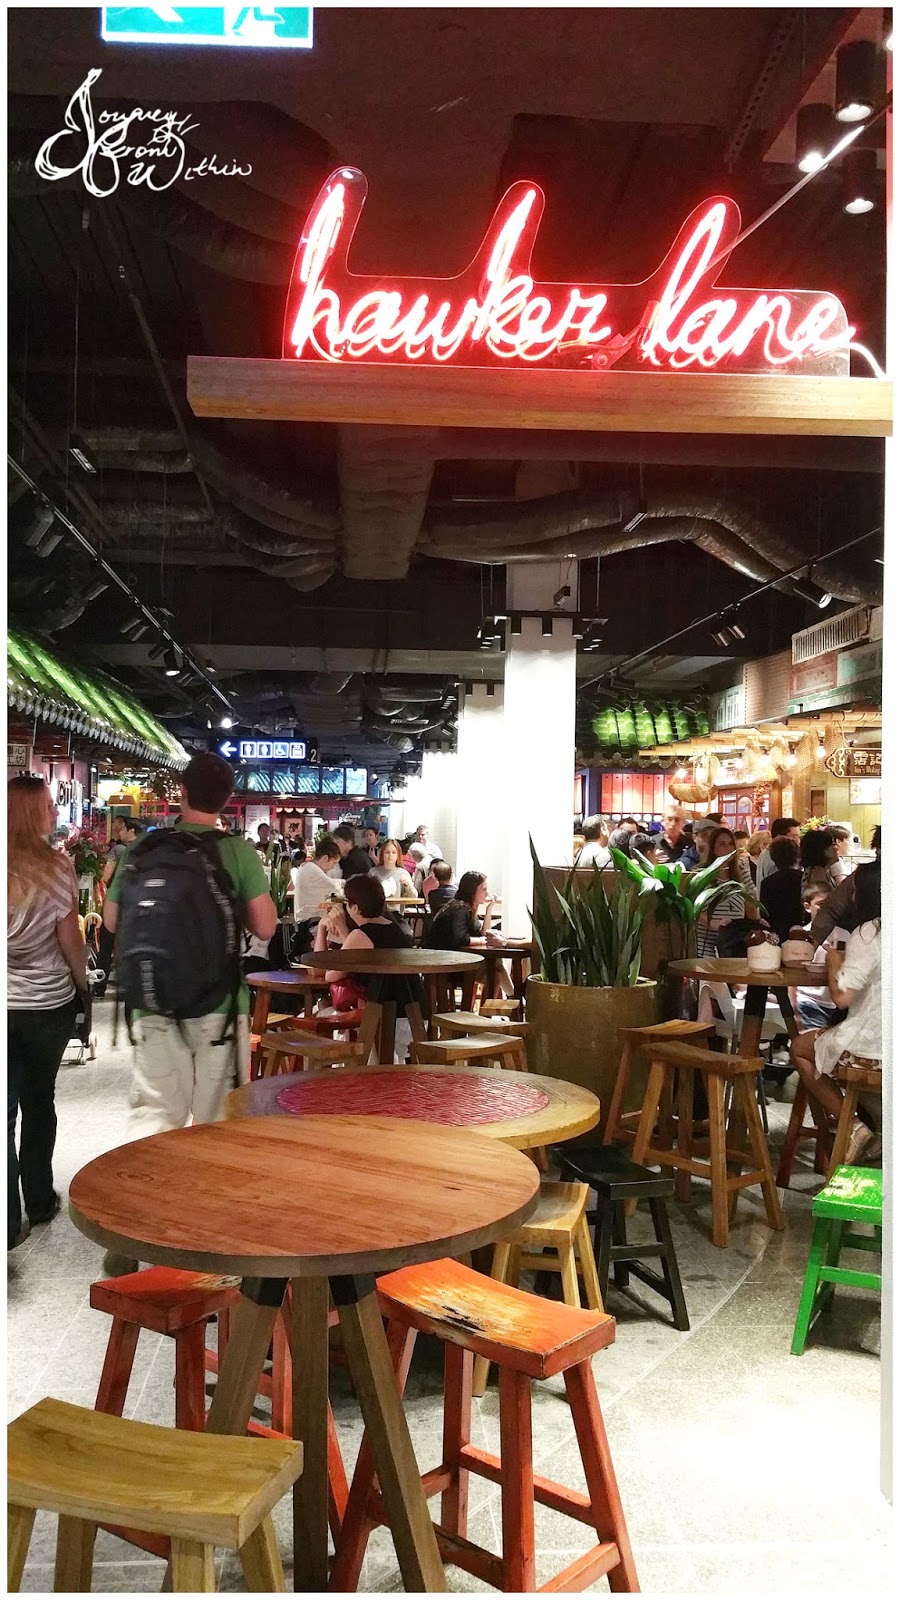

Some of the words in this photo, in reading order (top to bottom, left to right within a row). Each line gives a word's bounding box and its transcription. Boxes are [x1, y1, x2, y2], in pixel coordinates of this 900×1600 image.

[291, 183, 612, 363] hawker
[640, 202, 856, 367] lane
[310, 748, 317, 762] 2
